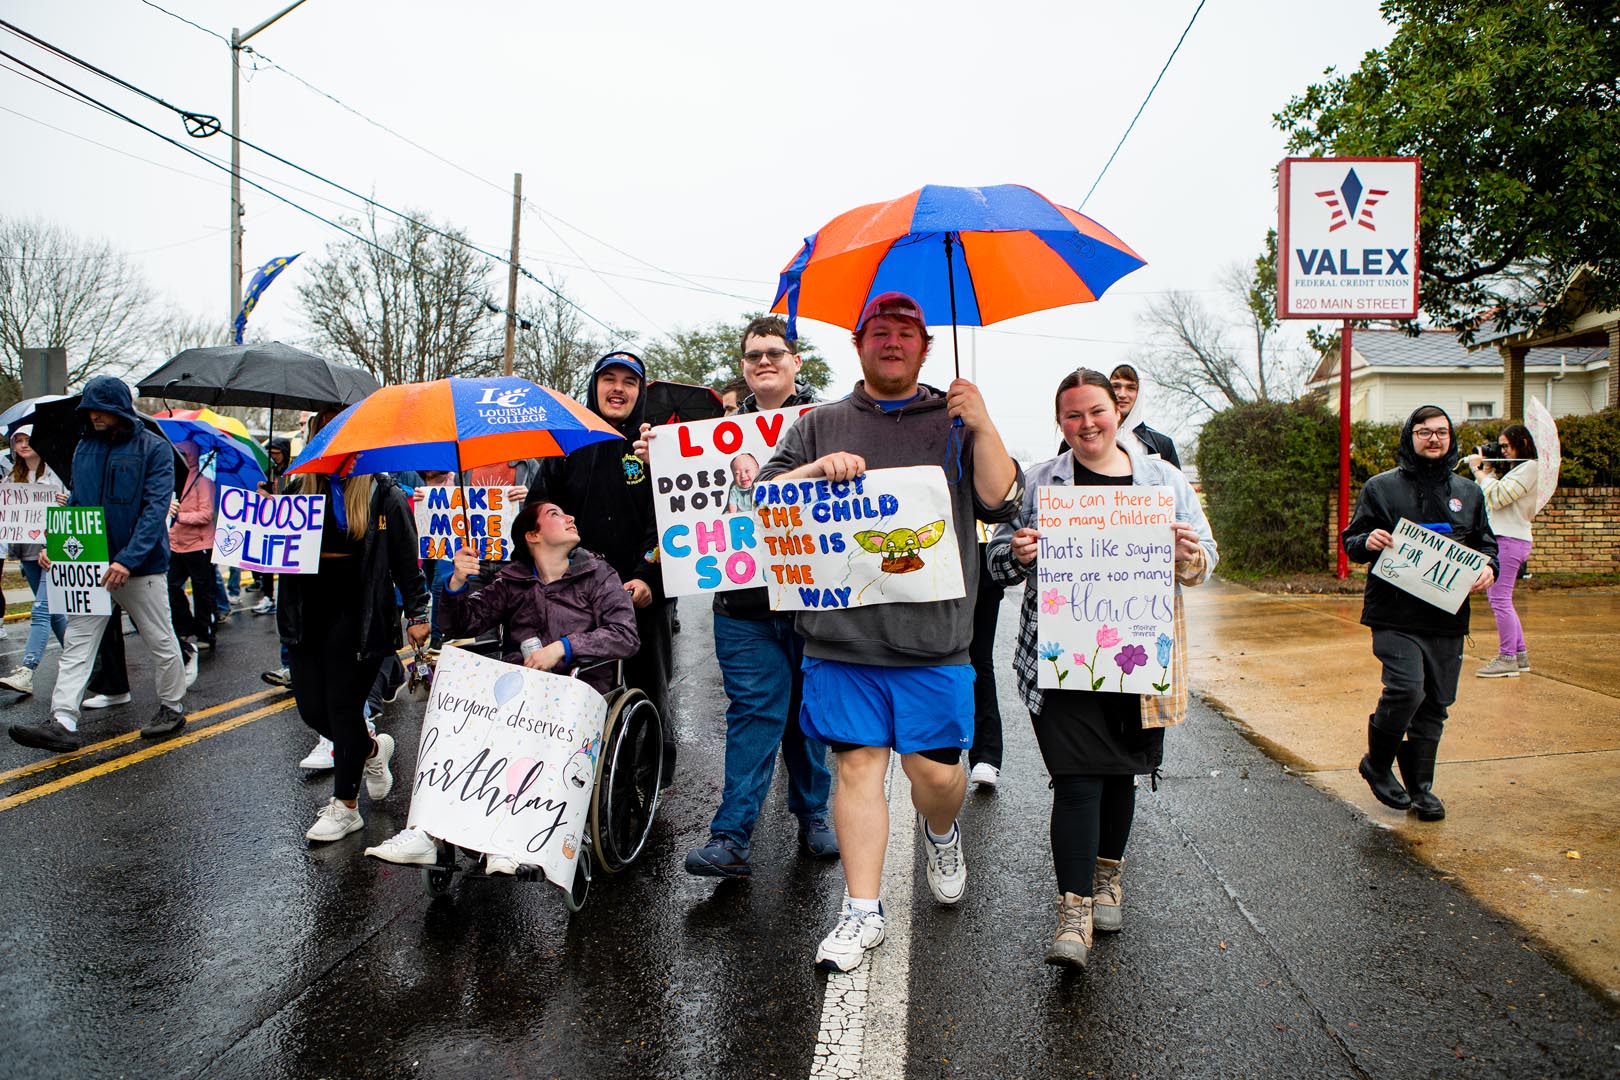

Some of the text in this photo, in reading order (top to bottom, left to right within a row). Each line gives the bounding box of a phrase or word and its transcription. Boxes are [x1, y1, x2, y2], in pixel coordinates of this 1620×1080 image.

[1295, 248, 1409, 275] VALEX
[1295, 279, 1409, 287] FEDERAL CREDIT UNION
[1295, 299, 1408, 310] 820 MAIN STREET
[478, 406, 547, 417] LOUISIANA
[487, 413, 547, 425] COLLEGE
[678, 405, 817, 457] LOV
[657, 468, 727, 494] DOES
[754, 473, 866, 506] PROTECT
[221, 488, 324, 531] CHOOSE
[427, 487, 503, 511] MAKE
[670, 490, 725, 513] NOT
[758, 493, 899, 528] THE CHILD
[1038, 488, 1174, 510] How can there be
[11, 510, 20, 522] IN
[25, 509, 42, 523] THE
[48, 510, 103, 534] LOVE LIFE
[429, 513, 502, 537] MORE
[1039, 513, 1062, 528] too
[1069, 515, 1106, 531] many
[0, 527, 23, 541] OMB
[662, 516, 757, 558] CHR
[764, 532, 846, 556] THIS IS
[1038, 536, 1083, 560] That's
[1125, 542, 1172, 564] saying
[1399, 522, 1485, 571] HUMAN RIGHTS
[51, 564, 102, 587] CHOOSE
[695, 551, 767, 589] SO
[771, 564, 814, 584] THE
[1039, 567, 1172, 586] there are too many
[1398, 542, 1461, 590] FOR ALL
[64, 590, 91, 613] LIFE
[799, 587, 852, 608] WAY
[1070, 582, 1173, 622] flowers
[507, 700, 574, 743] deserves
[414, 727, 568, 852] birthday
